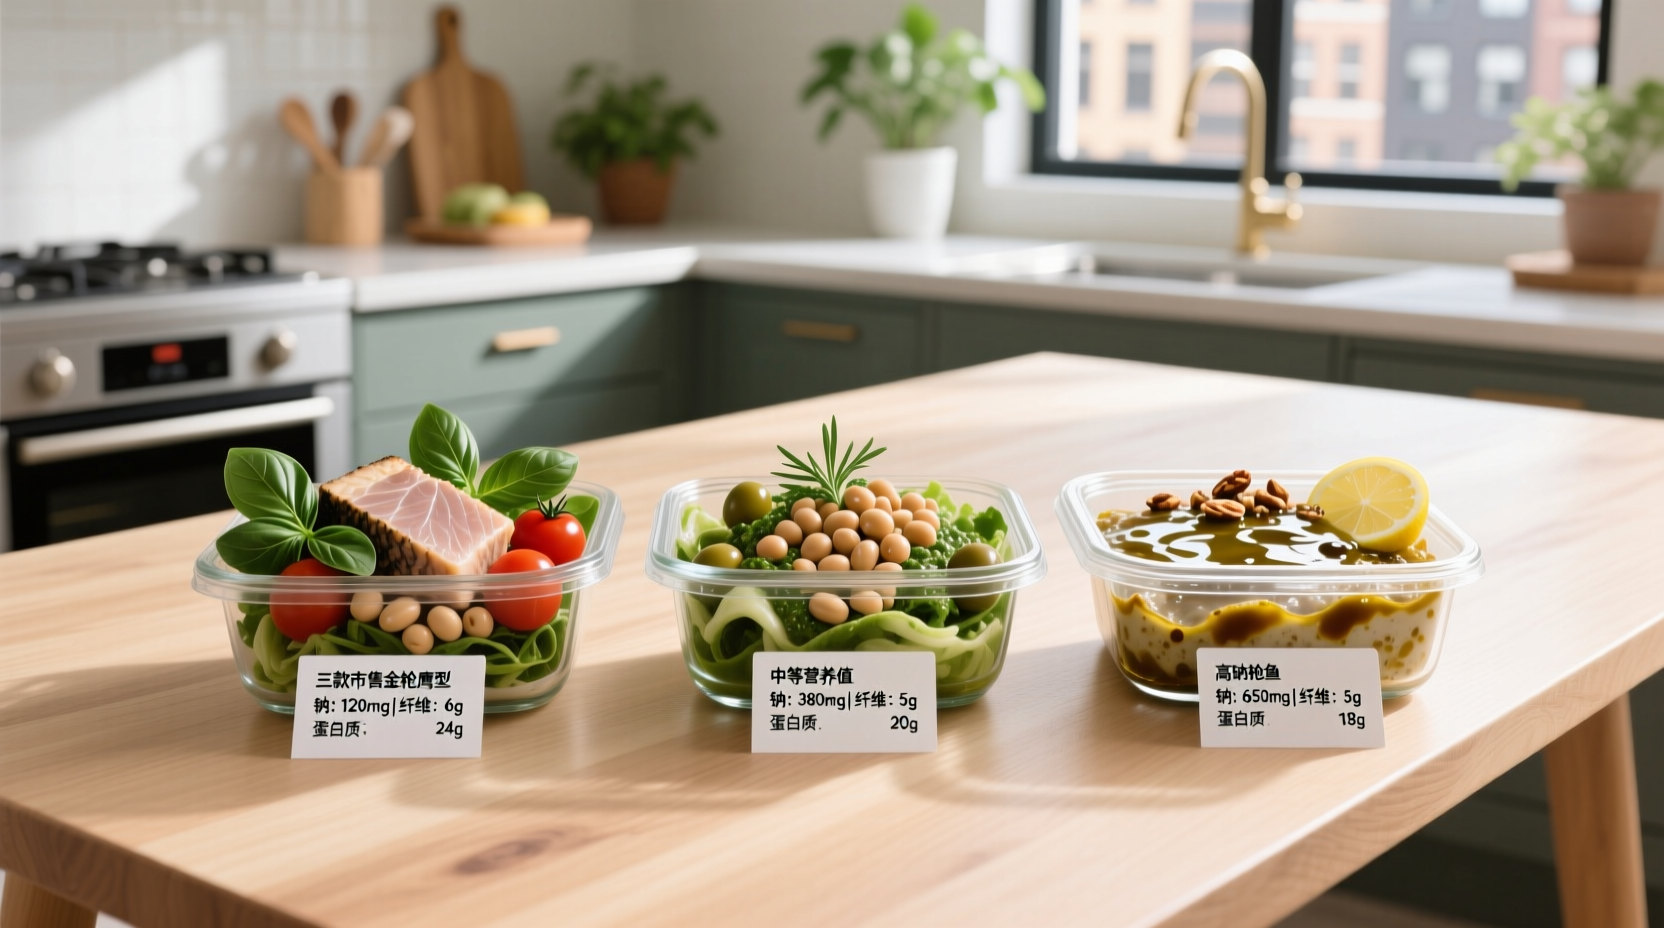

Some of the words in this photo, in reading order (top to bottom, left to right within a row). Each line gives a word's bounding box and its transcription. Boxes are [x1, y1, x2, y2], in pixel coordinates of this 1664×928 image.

[771, 666, 854, 686] 中等营养值
[445, 698, 463, 716] 6g
[899, 693, 917, 710] 5g
[1344, 690, 1361, 707] 5g
[890, 715, 918, 733] 20g
[1339, 712, 1365, 729] 18g
[436, 721, 463, 739] 24g
